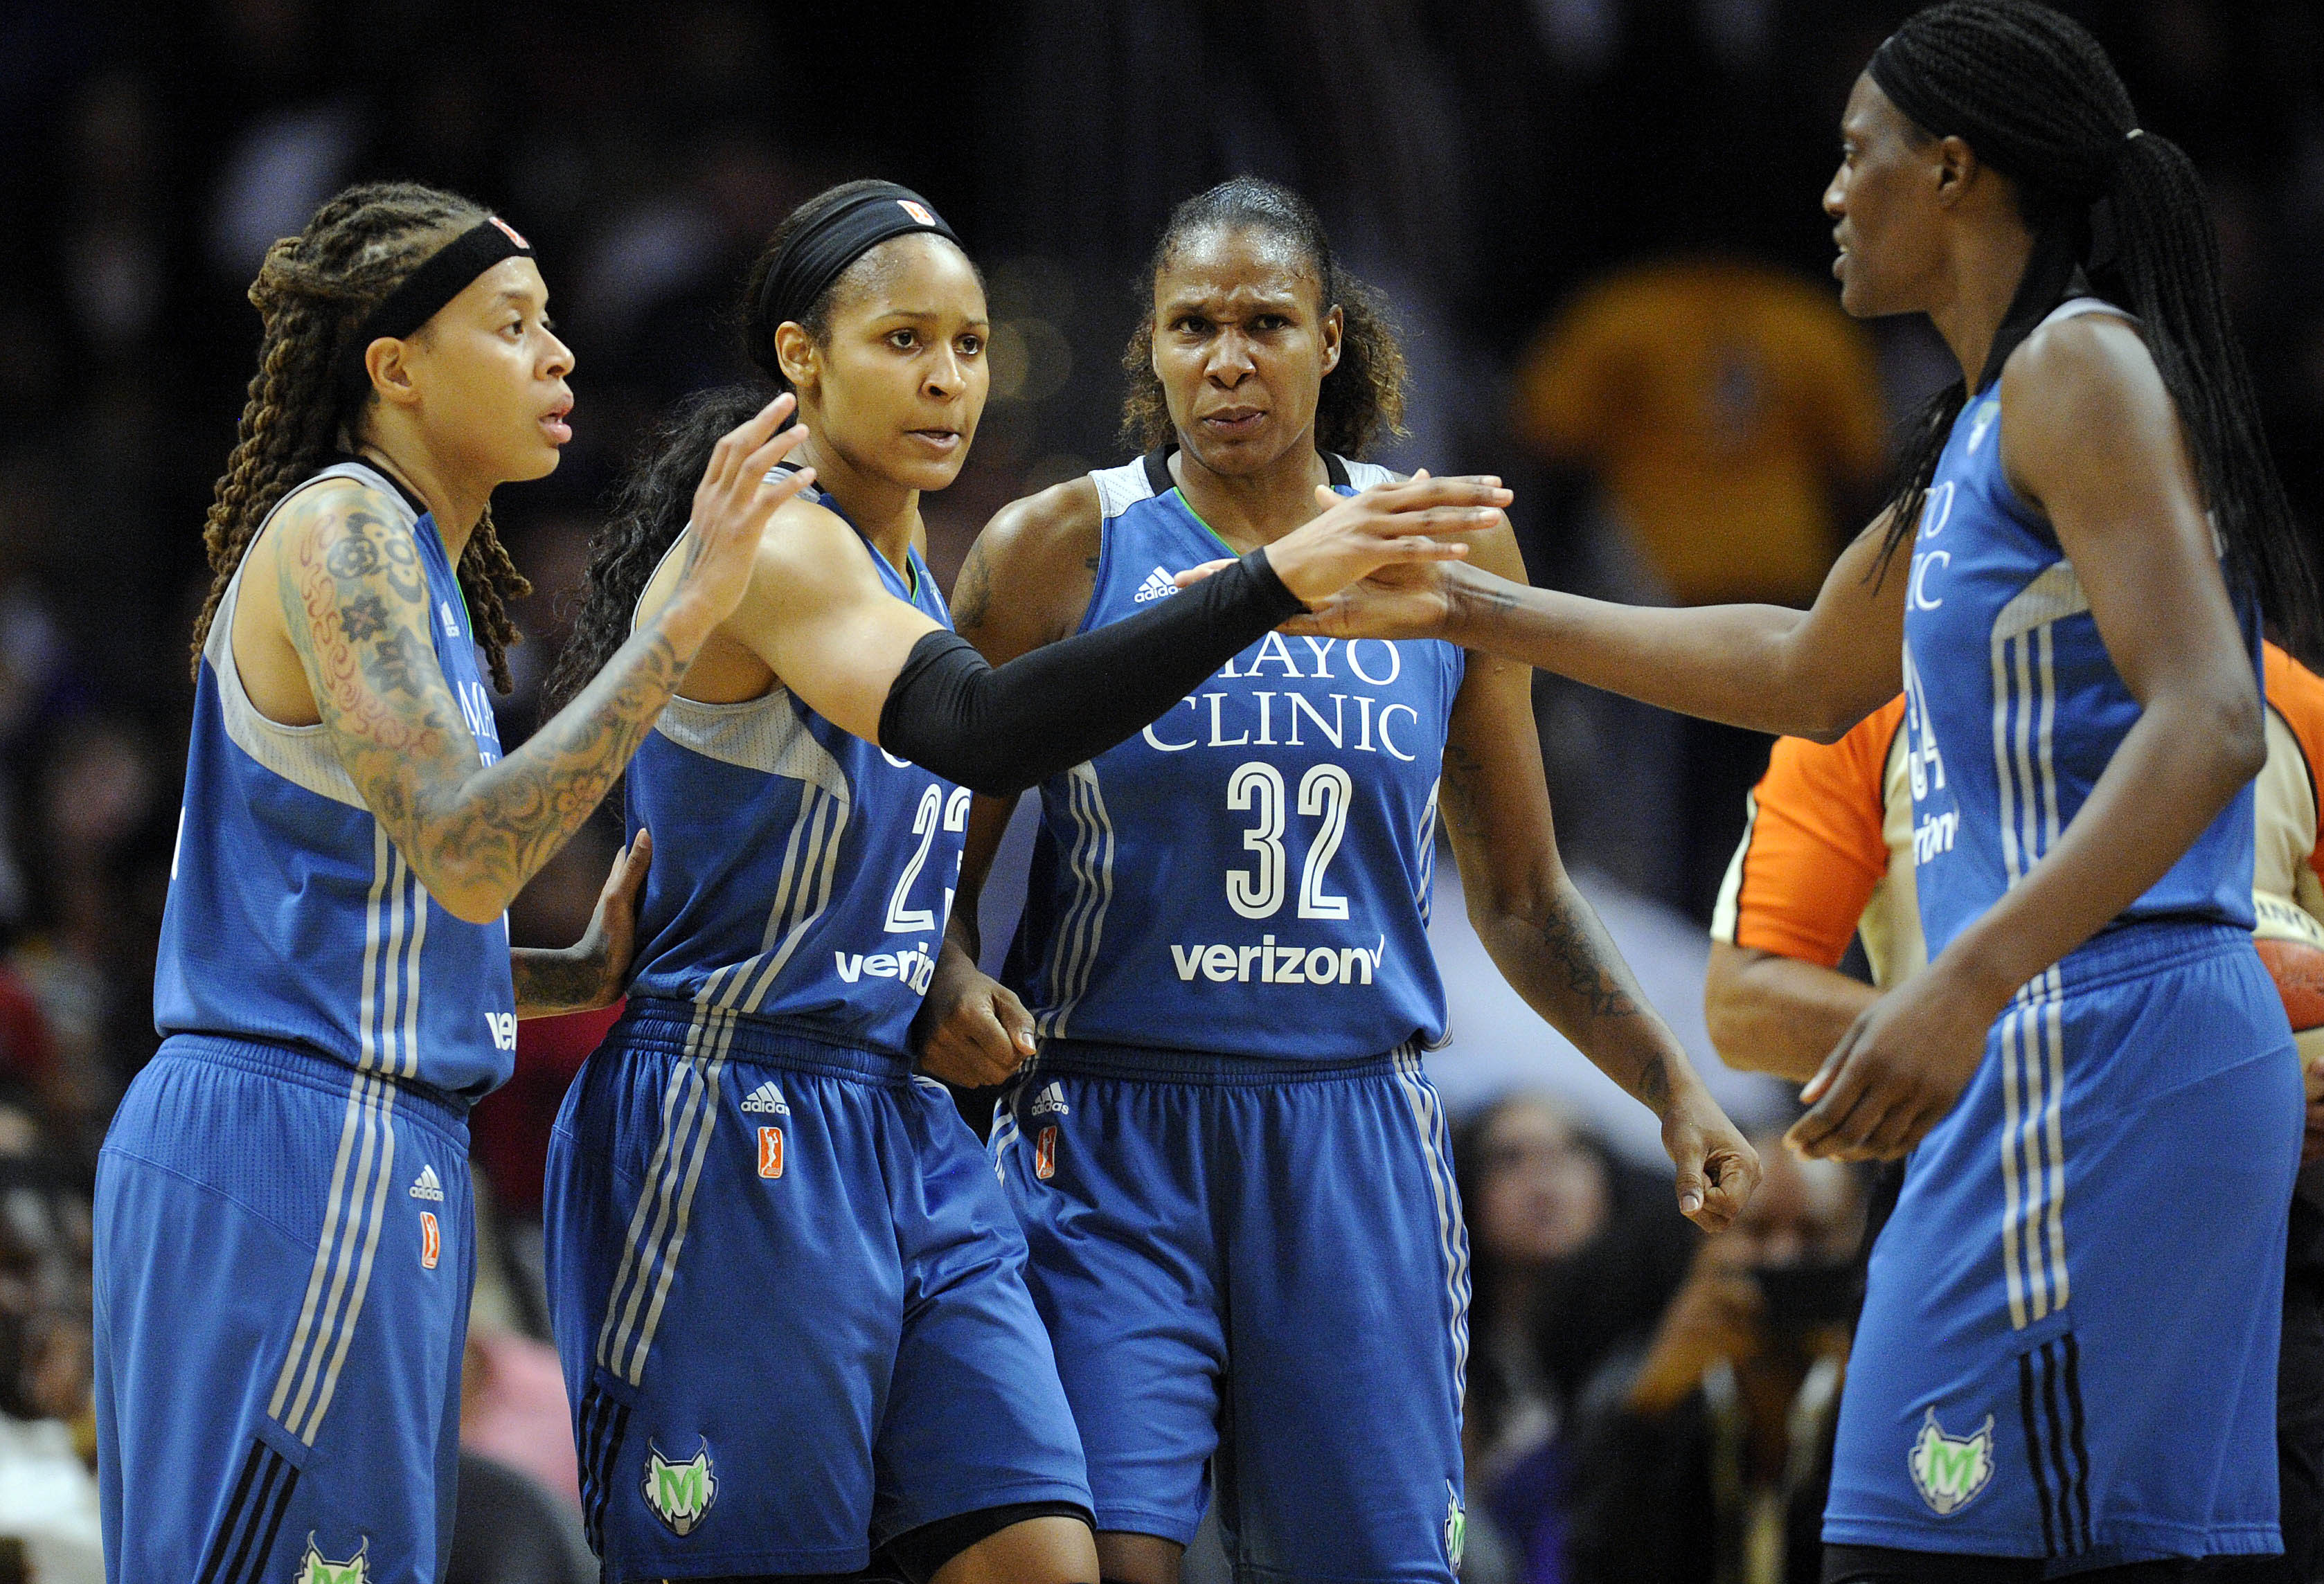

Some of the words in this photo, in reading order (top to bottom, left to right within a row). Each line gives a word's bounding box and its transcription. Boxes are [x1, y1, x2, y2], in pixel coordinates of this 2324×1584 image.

[1142, 691, 1419, 762] CLINIC
[1226, 762, 1353, 921] 32
[1171, 935, 1373, 984] verizon
[740, 1099, 791, 1116] adidas
[1032, 1100, 1069, 1115] adidas
